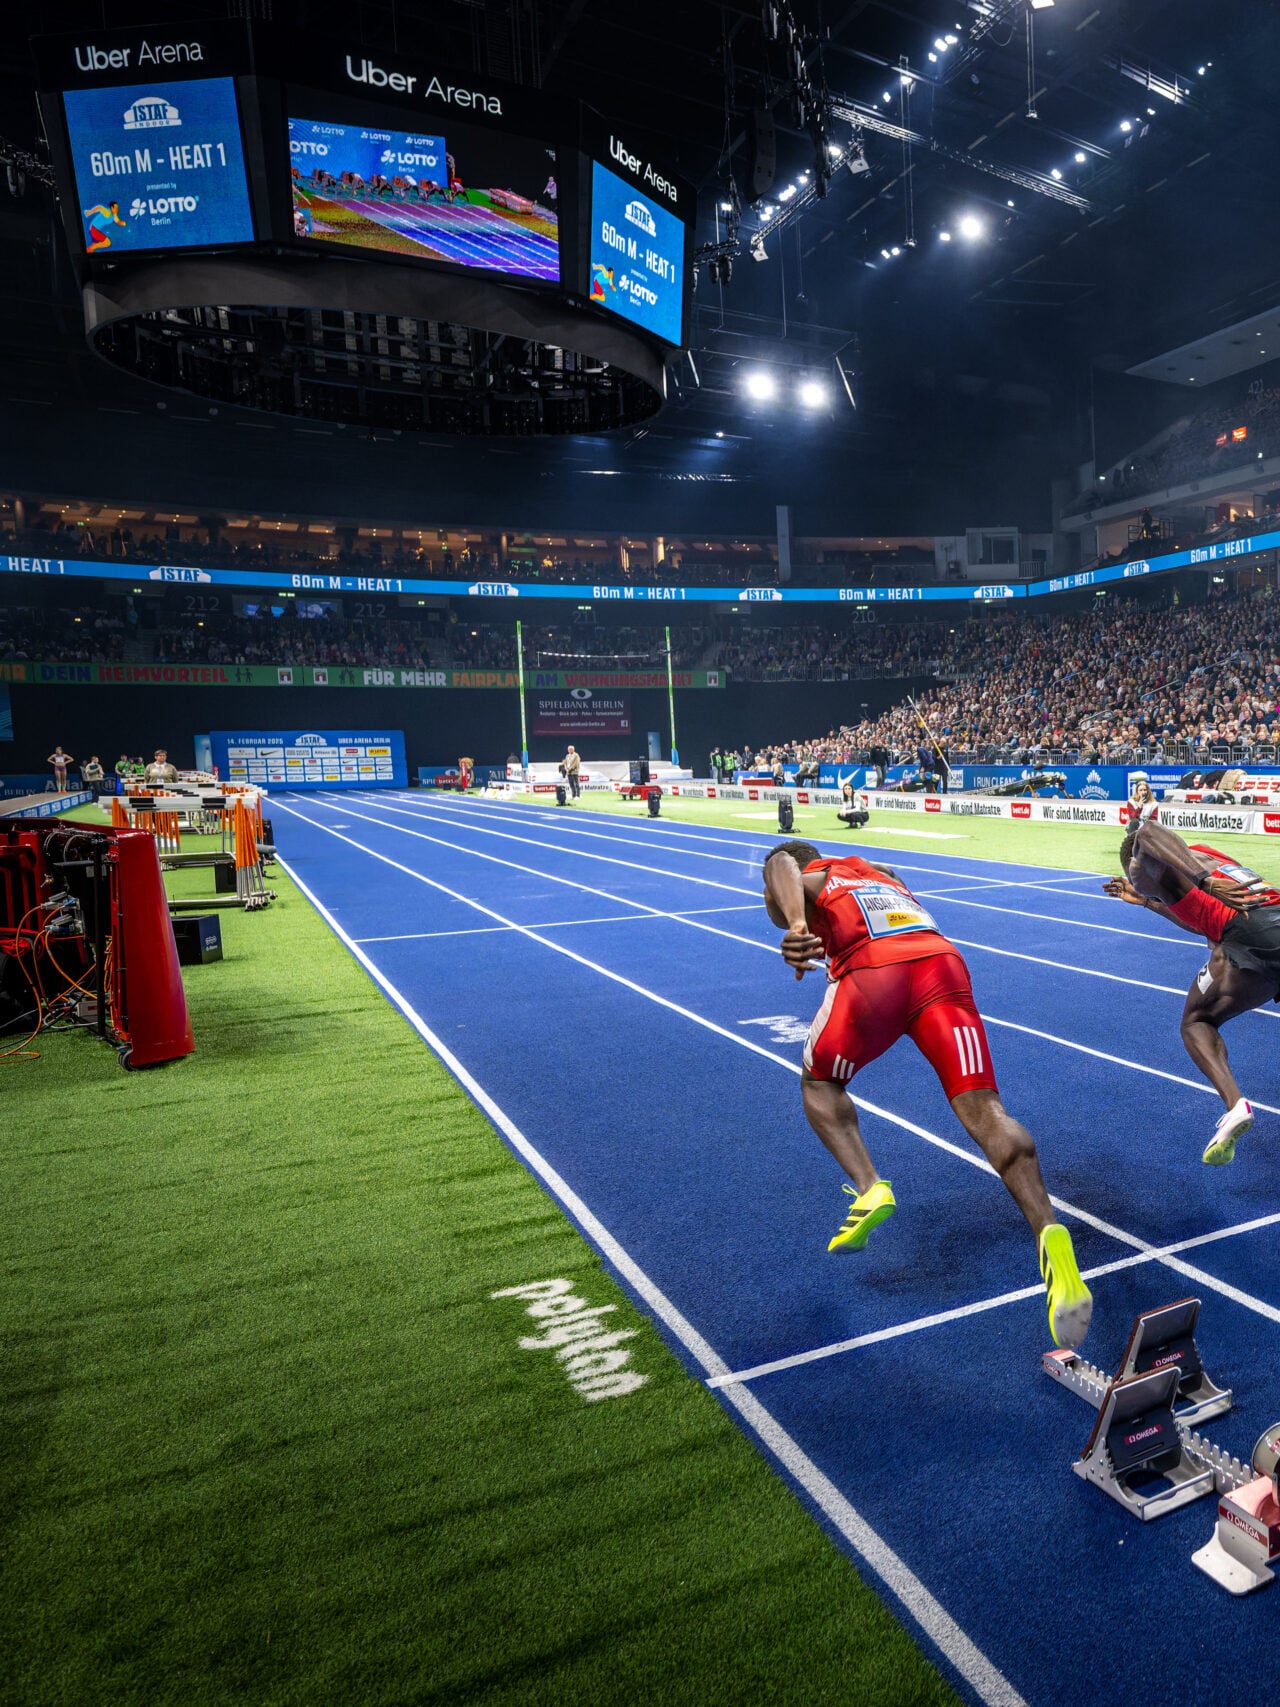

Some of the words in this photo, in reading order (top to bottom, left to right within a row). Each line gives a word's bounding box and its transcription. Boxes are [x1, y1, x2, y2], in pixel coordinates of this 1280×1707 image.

[75, 46, 131, 71] Uber
[138, 40, 203, 66] Arena
[346, 55, 417, 94] Uber
[425, 76, 503, 115] Arena
[132, 103, 169, 121] ISTAF
[90, 151, 132, 177] 60m
[135, 149, 152, 173] M
[169, 144, 212, 170] HEAT
[217, 142, 227, 166] 1
[397, 152, 437, 167] LOTTO
[610, 135, 642, 175] Uber
[643, 163, 678, 202] Arena
[149, 195, 197, 214] LOTTO
[151, 217, 171, 226] Berlin
[601, 221, 626, 253] 60m
[627, 237, 637, 261] M
[645, 248, 670, 280] HEAT
[669, 264, 675, 284] 1
[629, 279, 657, 306] LOTTO
[1190, 548, 1208, 564] 60m
[1209, 546, 1217, 560] M
[1224, 540, 1245, 557] HEAT
[1246, 538, 1252, 552] 1
[8, 558, 52, 574] HEAT
[57, 560, 66, 575] 1
[159, 566, 201, 583] ISTAF
[1127, 561, 1146, 577] ISTAF
[291, 574, 325, 590] 60m
[329, 576, 342, 590] M
[357, 577, 395, 593] HEAT
[397, 579, 403, 593] 1
[477, 582, 510, 597] ISTAF
[1049, 579, 1063, 592] 60m
[1063, 577, 1070, 589] M
[1074, 572, 1090, 588] HEAT
[1091, 571, 1095, 584] 1
[593, 586, 618, 599] 60m
[625, 586, 635, 600] M
[648, 587, 677, 600] HEAT
[680, 587, 686, 600] 1
[746, 588, 775, 601] ISTAF
[839, 588, 864, 601] 60m
[866, 588, 877, 601] M
[888, 588, 915, 600] HEAT
[917, 588, 923, 600] 1
[981, 585, 1007, 599] ISTAF
[185, 595, 222, 612] 212
[354, 602, 388, 618] 212
[572, 610, 597, 624] 211
[851, 610, 877, 624] 210
[41, 664, 92, 682] DEIN
[98, 666, 230, 684] HEIMVORTEIL
[363, 667, 396, 686] FÜR
[400, 671, 447, 687] MEHR
[535, 673, 558, 687] AM
[538, 700, 589, 710] SPIELBANK
[592, 700, 625, 710] BERLIN
[875, 797, 883, 808] Wir
[883, 797, 894, 809] sind
[894, 798, 917, 810] Matratze
[950, 801, 959, 813] Wir
[959, 801, 973, 814] sind
[973, 803, 1001, 816] Matratze
[1042, 805, 1054, 819] Wir
[1055, 806, 1072, 820] sind
[1072, 807, 1106, 822] Matratze
[1160, 810, 1175, 825] Wir
[1176, 811, 1197, 827] sind
[1199, 813, 1243, 830] Matratze
[1161, 1352, 1183, 1366] OMEGA
[1135, 1425, 1159, 1442] OMEGA
[1233, 1514, 1261, 1542] OMEGA
